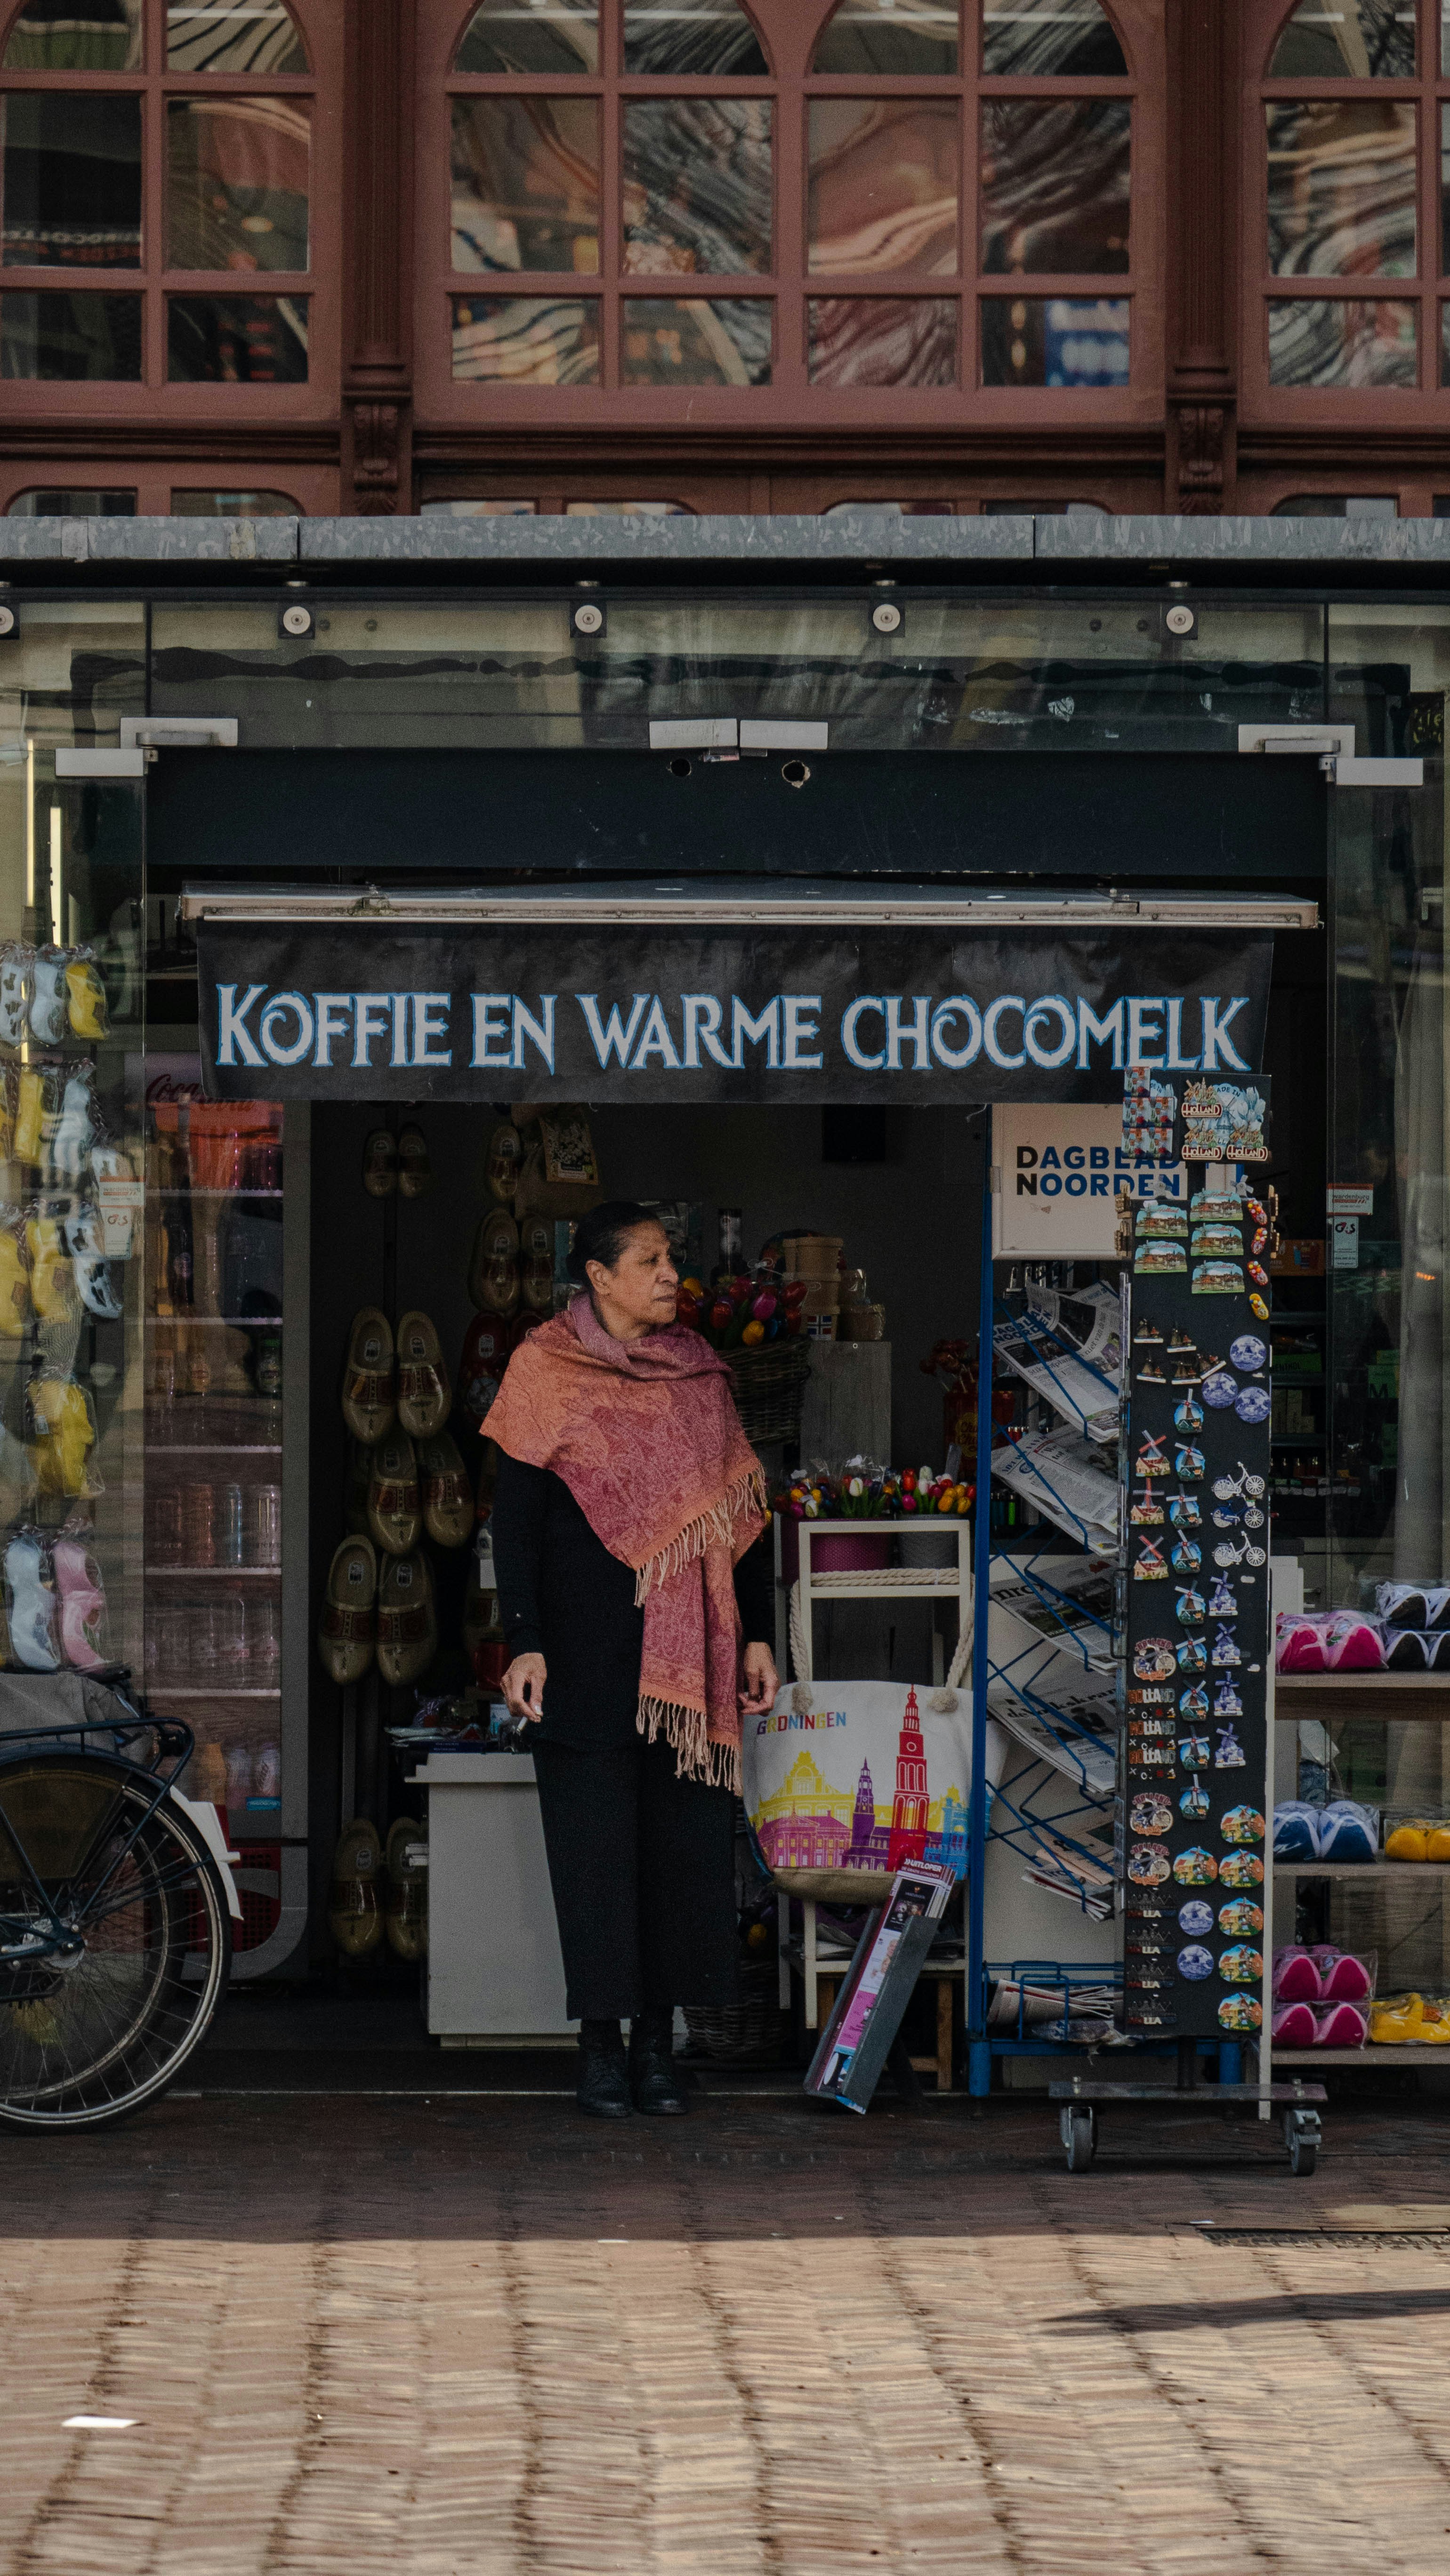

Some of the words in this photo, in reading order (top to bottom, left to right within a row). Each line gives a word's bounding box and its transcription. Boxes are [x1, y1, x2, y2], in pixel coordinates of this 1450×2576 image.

[215, 983, 452, 1067] KOFFIE
[469, 994, 558, 1076] EN
[575, 994, 823, 1070] WARME
[841, 994, 1252, 1071] CHOCOMELK
[1182, 1103, 1221, 1116] HOLLAND
[1182, 1145, 1221, 1159] HOLLAND
[1227, 1145, 1266, 1159] HOLLAND
[757, 1711, 846, 1735] GRONINGEN
